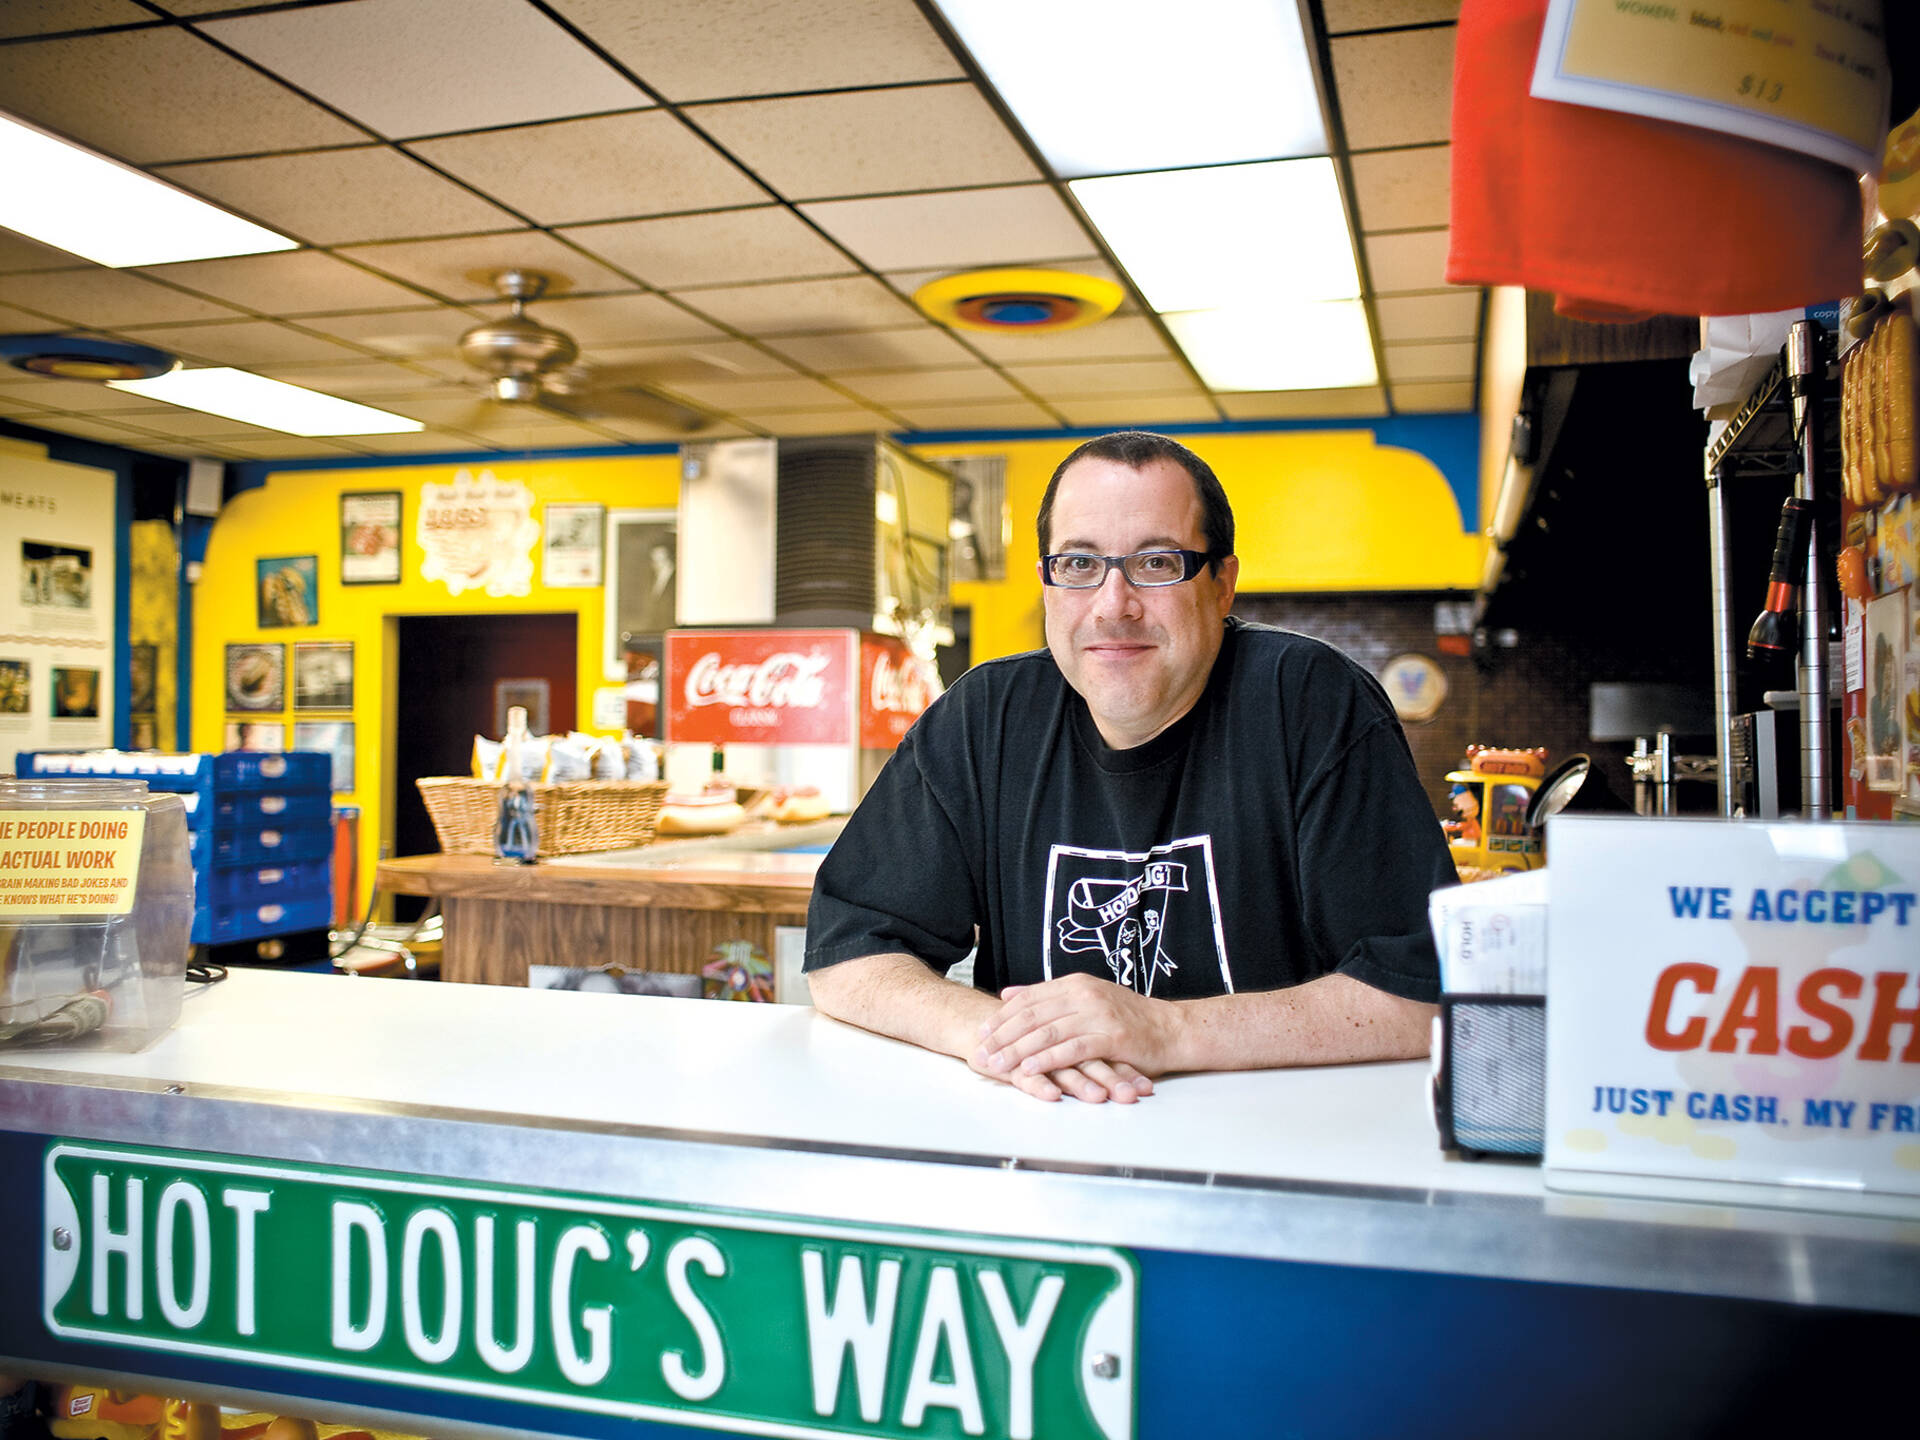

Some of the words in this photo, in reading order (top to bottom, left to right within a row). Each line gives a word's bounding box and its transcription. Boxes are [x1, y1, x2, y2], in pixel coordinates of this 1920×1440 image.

[1737, 72, 1784, 103] $13
[16, 821, 77, 839] PEOPLE
[79, 821, 128, 839] DOING
[0, 851, 61, 869] ACTUAL
[66, 850, 117, 869] WORK
[23, 878, 60, 888] MAKING
[61, 878, 80, 888] BAD
[80, 878, 110, 888] JOKES
[110, 878, 128, 888] AND
[4, 894, 38, 904] KNOWS
[39, 894, 66, 904] WHAT
[66, 894, 88, 904] HE'S
[1668, 886, 1733, 921] WE
[1746, 888, 1917, 926] ACCEPT
[1645, 961, 1920, 1064] CASH
[1593, 1085, 1674, 1118] JUST
[1803, 1099, 1857, 1129] MY
[1868, 1102, 1920, 1133] FR
[91, 1172, 272, 1337] HOT
[331, 1198, 728, 1401] DOUG'S
[802, 1249, 1066, 1440] WAY
